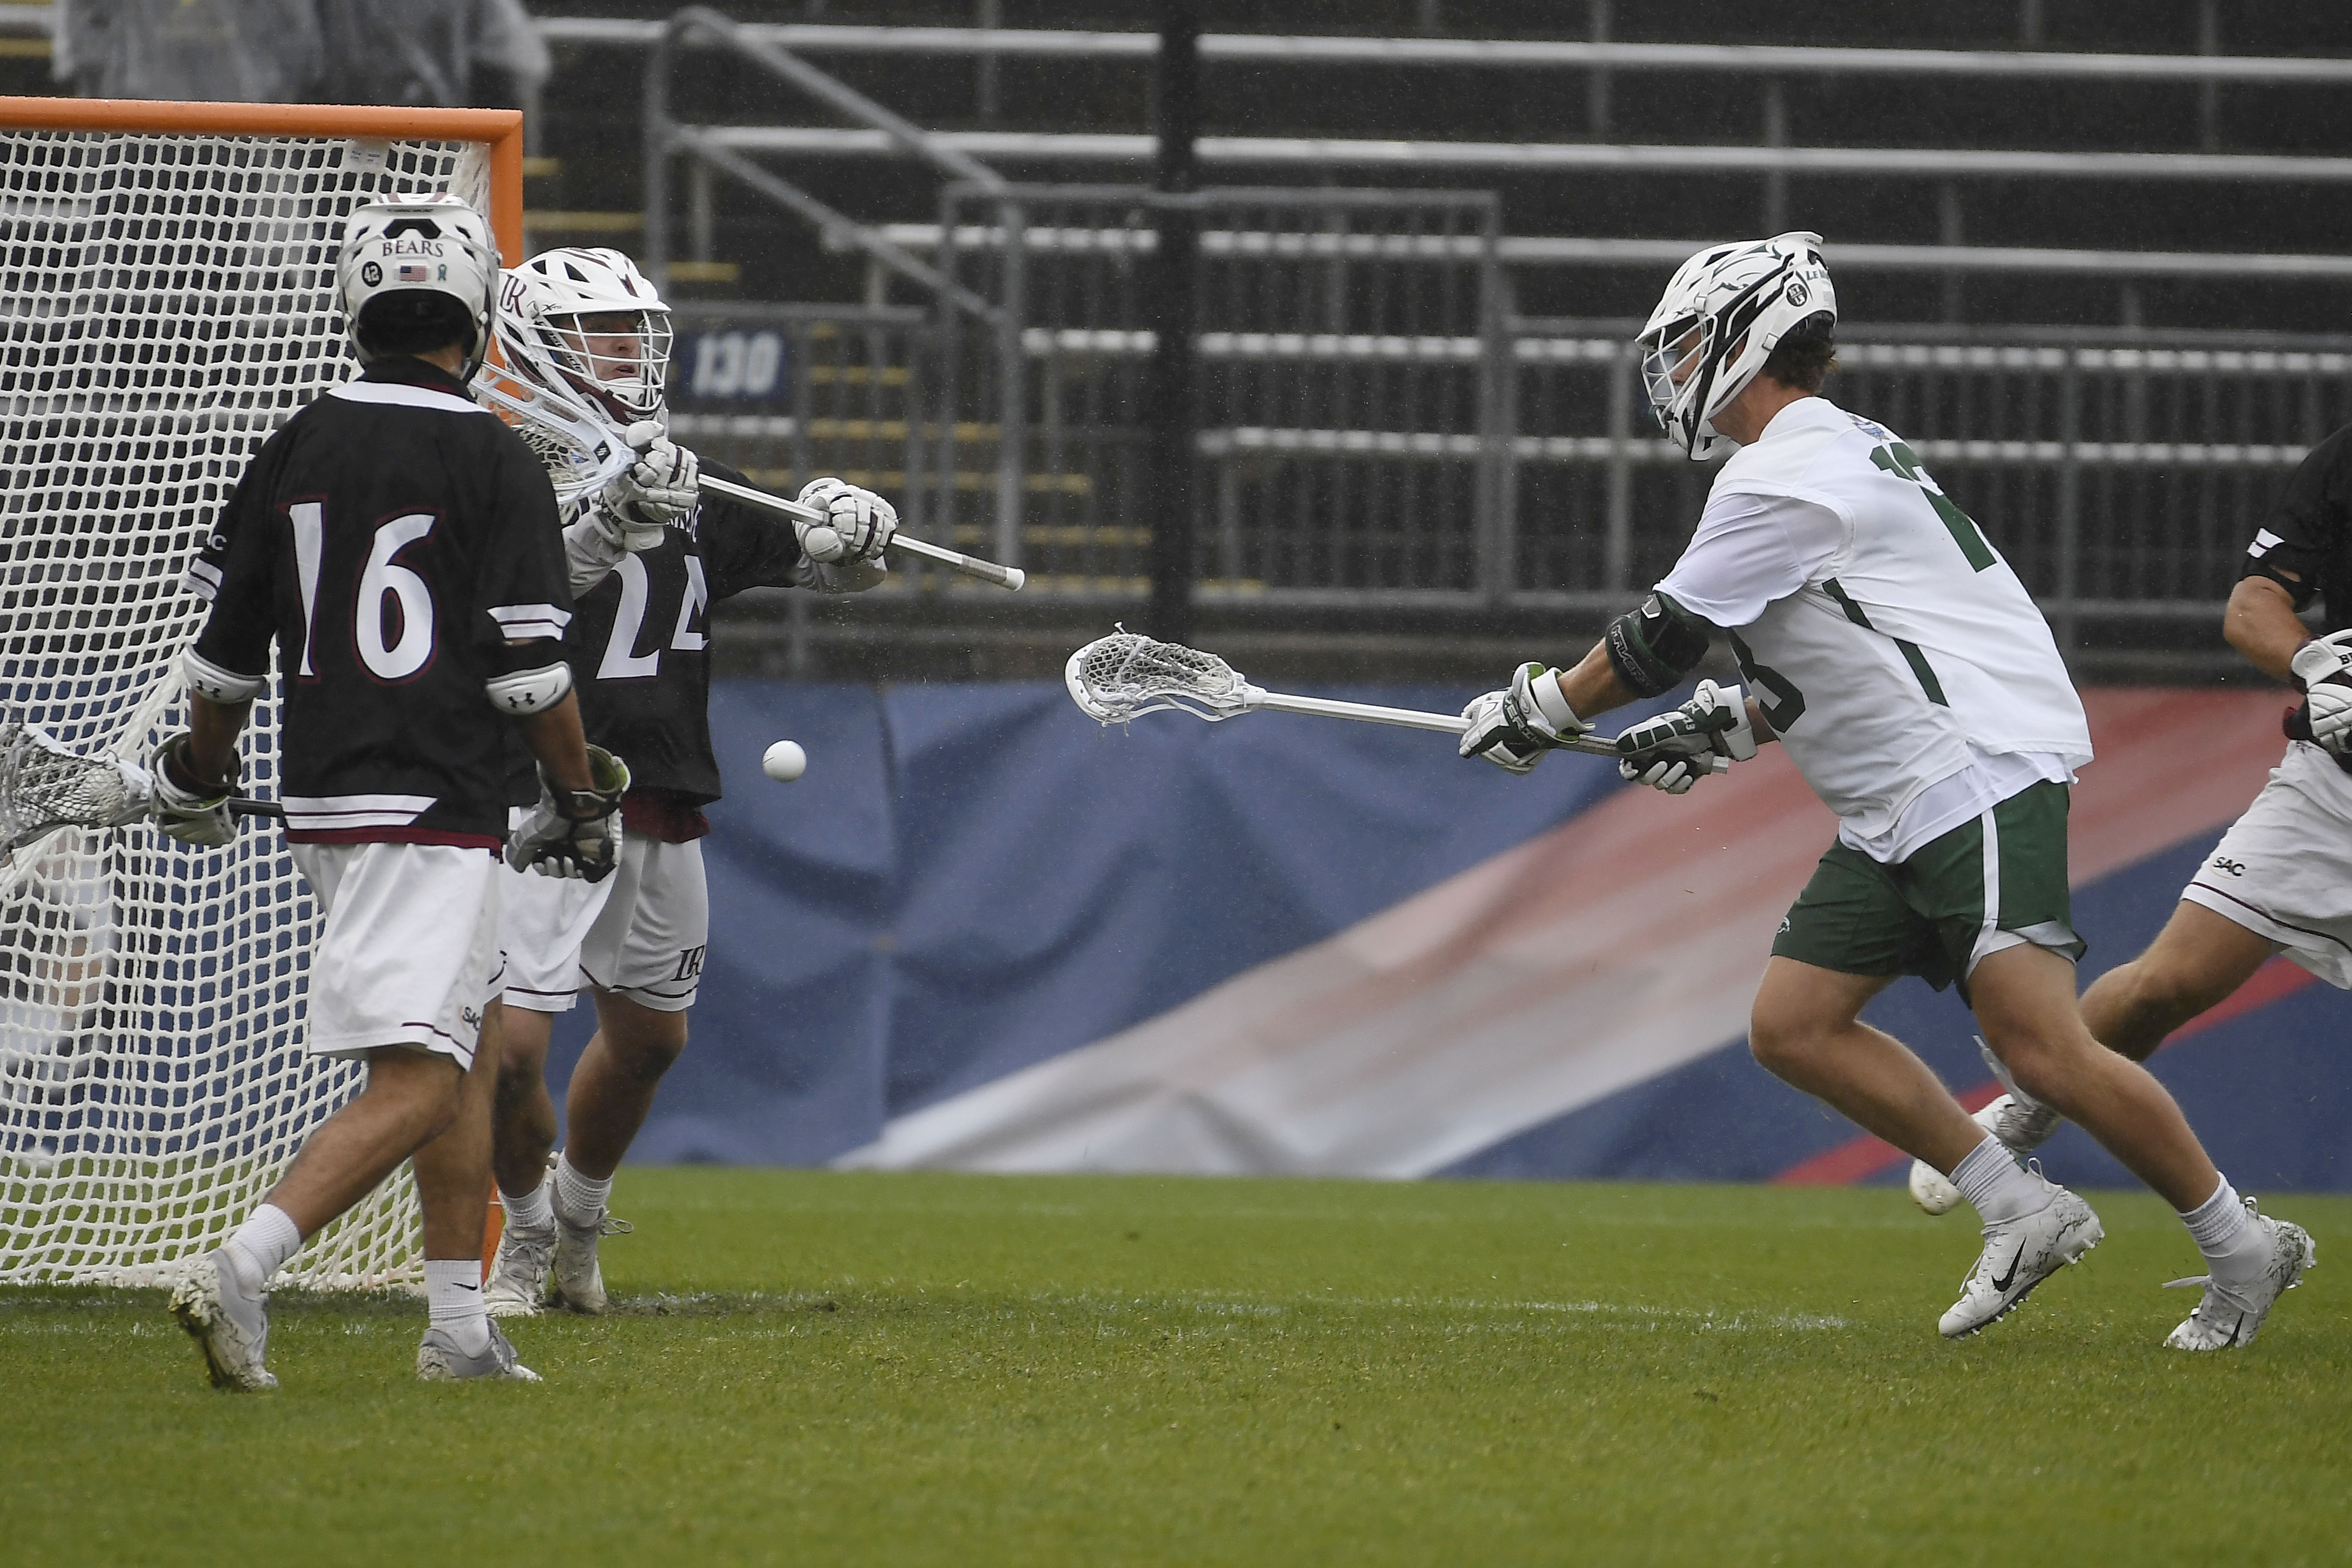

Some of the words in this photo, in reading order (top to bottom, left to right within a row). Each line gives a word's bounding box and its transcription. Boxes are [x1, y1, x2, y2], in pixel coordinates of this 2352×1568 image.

[382, 240, 443, 257] BEARS
[364, 265, 380, 282] 42
[693, 333, 782, 395] 130
[288, 500, 437, 680] 16
[596, 552, 710, 680] 24
[2213, 857, 2246, 876] SAC
